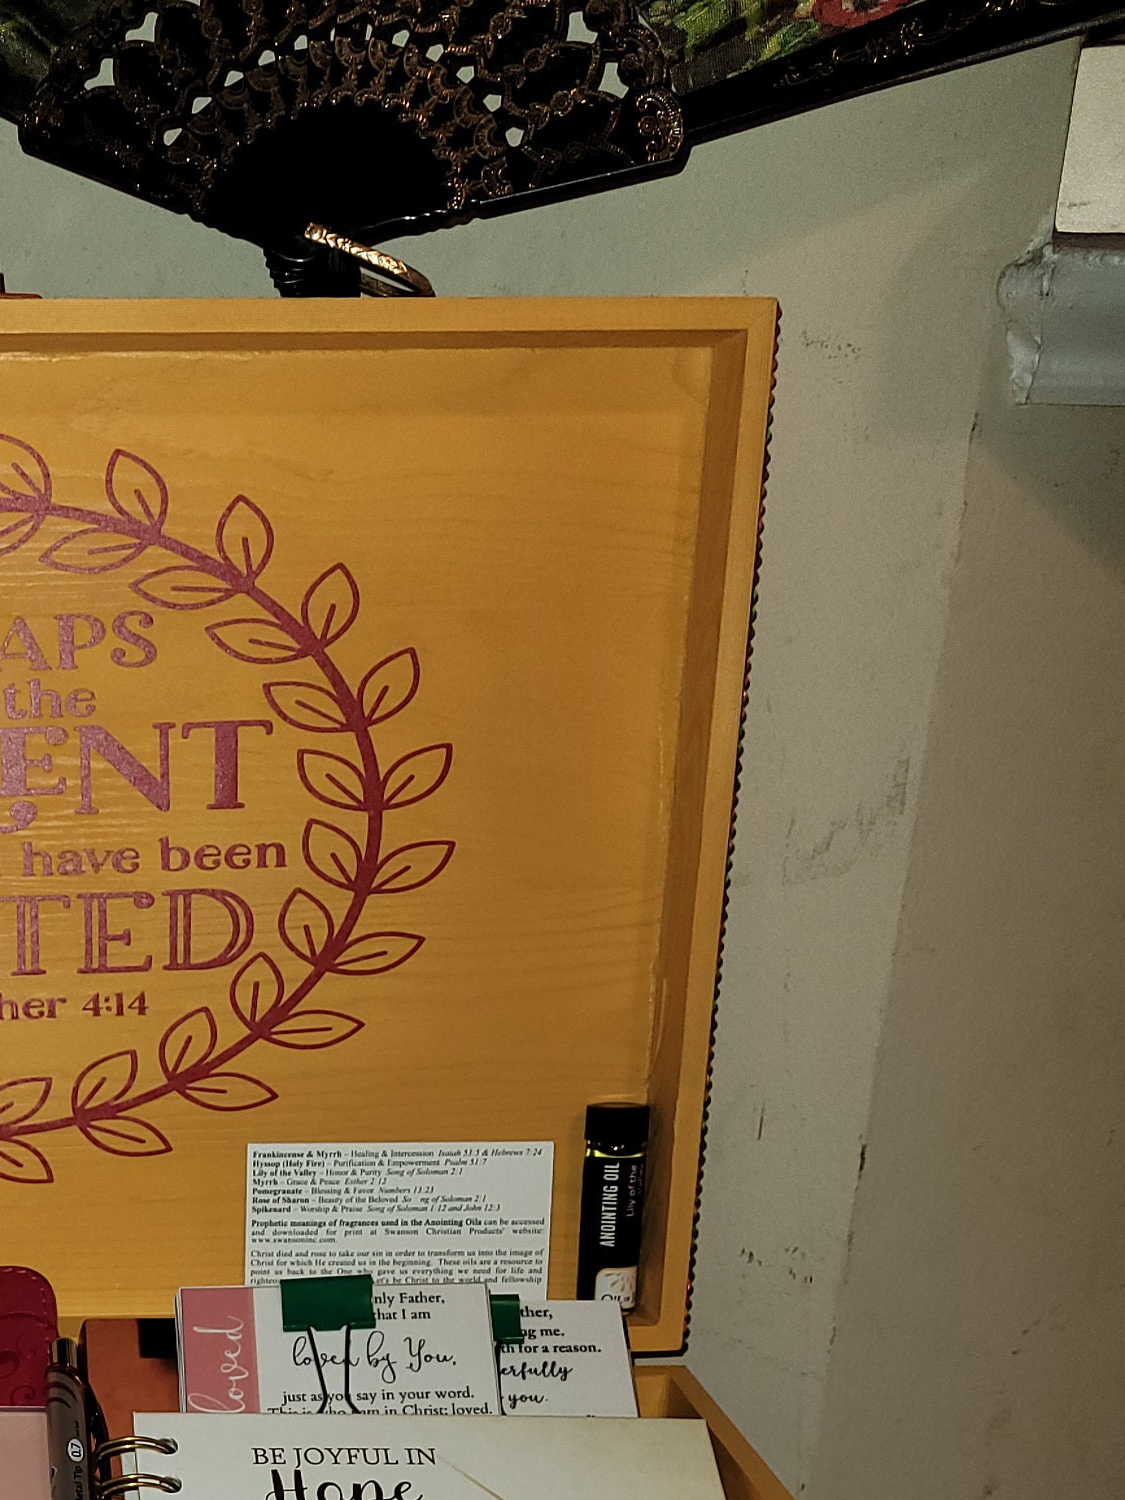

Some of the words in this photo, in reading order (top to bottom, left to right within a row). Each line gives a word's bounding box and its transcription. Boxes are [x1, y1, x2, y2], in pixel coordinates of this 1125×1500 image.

[3, 678, 96, 719] the
[21, 841, 140, 877] have
[158, 836, 286, 872] been
[82, 991, 149, 1016] 4:14
[316, 1150, 341, 1159] Myrrh
[603, 1162, 620, 1181] OIL
[628, 1185, 636, 1197] of
[600, 1185, 618, 1247] ANOINTING
[627, 1199, 637, 1217] Lily
[251, 1220, 288, 1228] Prophetic
[290, 1220, 326, 1228] meanings
[339, 1220, 378, 1228] fragrances
[424, 1219, 463, 1227] Anointing
[465, 1218, 481, 1226] Oils
[344, 1229, 363, 1237] print
[399, 1291, 445, 1304] Father,
[402, 1308, 406, 1319] I
[411, 1311, 431, 1319] am
[540, 1328, 565, 1336] me.
[367, 1330, 397, 1384] by
[404, 1337, 456, 1372] You.
[542, 1345, 549, 1353] a
[553, 1344, 601, 1353] reason.
[188, 1315, 249, 1413] loved
[501, 1360, 573, 1381] erfully
[282, 1391, 307, 1406] just
[310, 1393, 323, 1401] as
[326, 1392, 344, 1405] yo
[356, 1391, 377, 1404] say
[382, 1389, 394, 1400] in
[399, 1391, 431, 1404] your
[435, 1386, 474, 1398] word.
[452, 1402, 493, 1415] loved.
[70, 1442, 82, 1458] 0.7
[252, 1448, 287, 1465] BE
[294, 1448, 399, 1469] JOYFUL
[404, 1448, 436, 1465] IN
